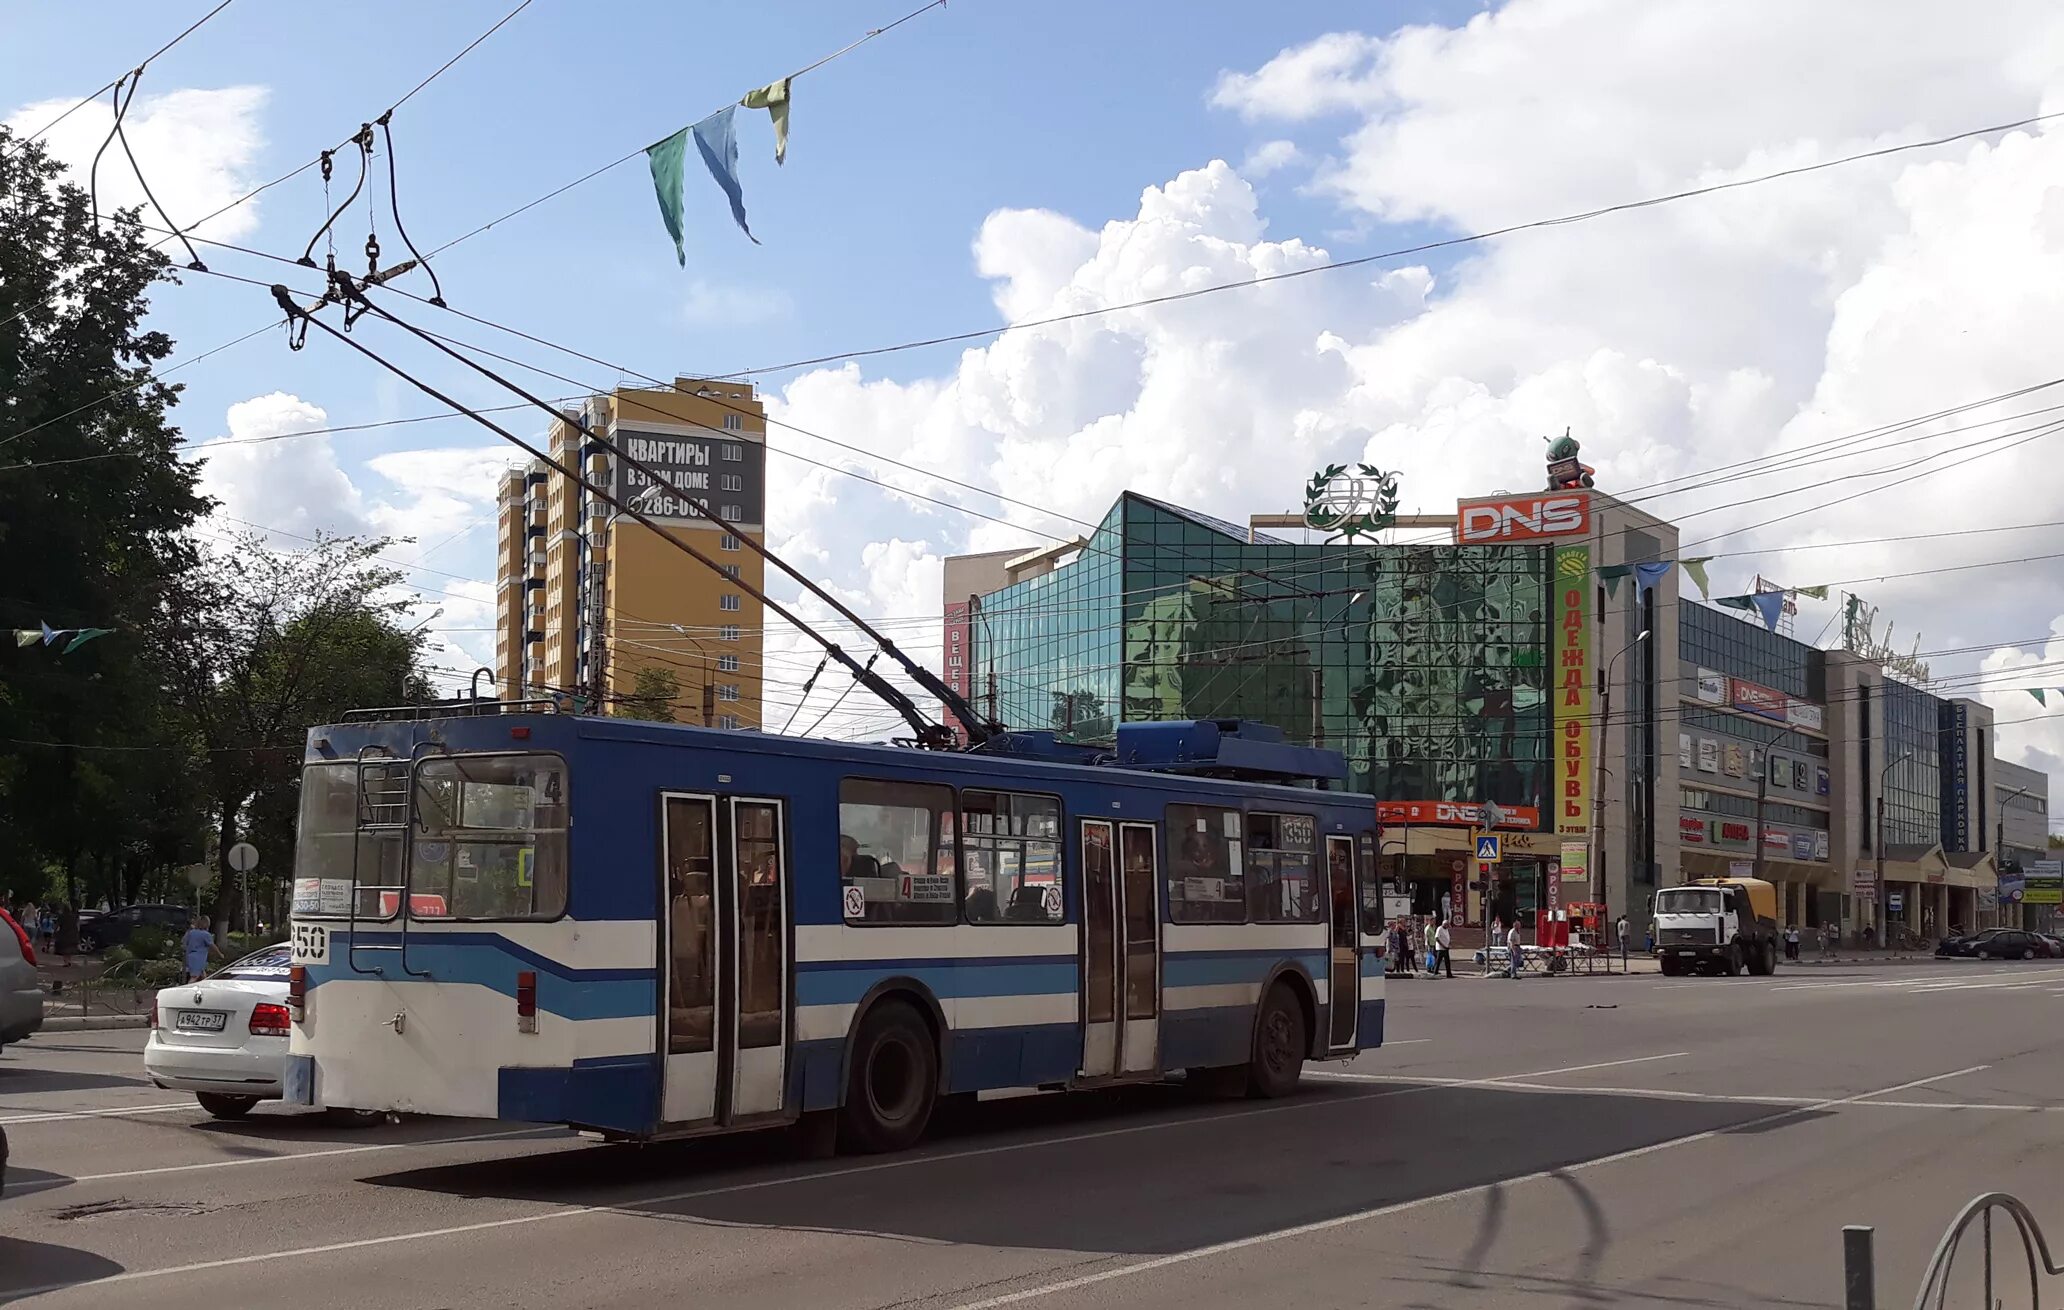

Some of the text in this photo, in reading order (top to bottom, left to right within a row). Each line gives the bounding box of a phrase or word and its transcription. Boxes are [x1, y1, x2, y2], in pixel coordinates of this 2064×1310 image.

[627, 438, 710, 466] КВАРТИРЫ
[627, 468, 636, 486] В
[674, 471, 709, 491] ДОМЕ
[1463, 498, 1583, 540] DNS
[1562, 589, 1584, 706] ОДЕЖДА
[1564, 720, 1582, 817] ОБУВЬ
[1956, 705, 1966, 852] БЕСПЛАТНАЯ ПАРКОВКА
[545, 771, 561, 802] 4
[1436, 803, 1480, 823] DNS
[1559, 825, 1565, 833] 3
[902, 876, 911, 899] 4
[1454, 874, 1464, 912] РОЗЫ
[1549, 875, 1559, 908] РОЗ
